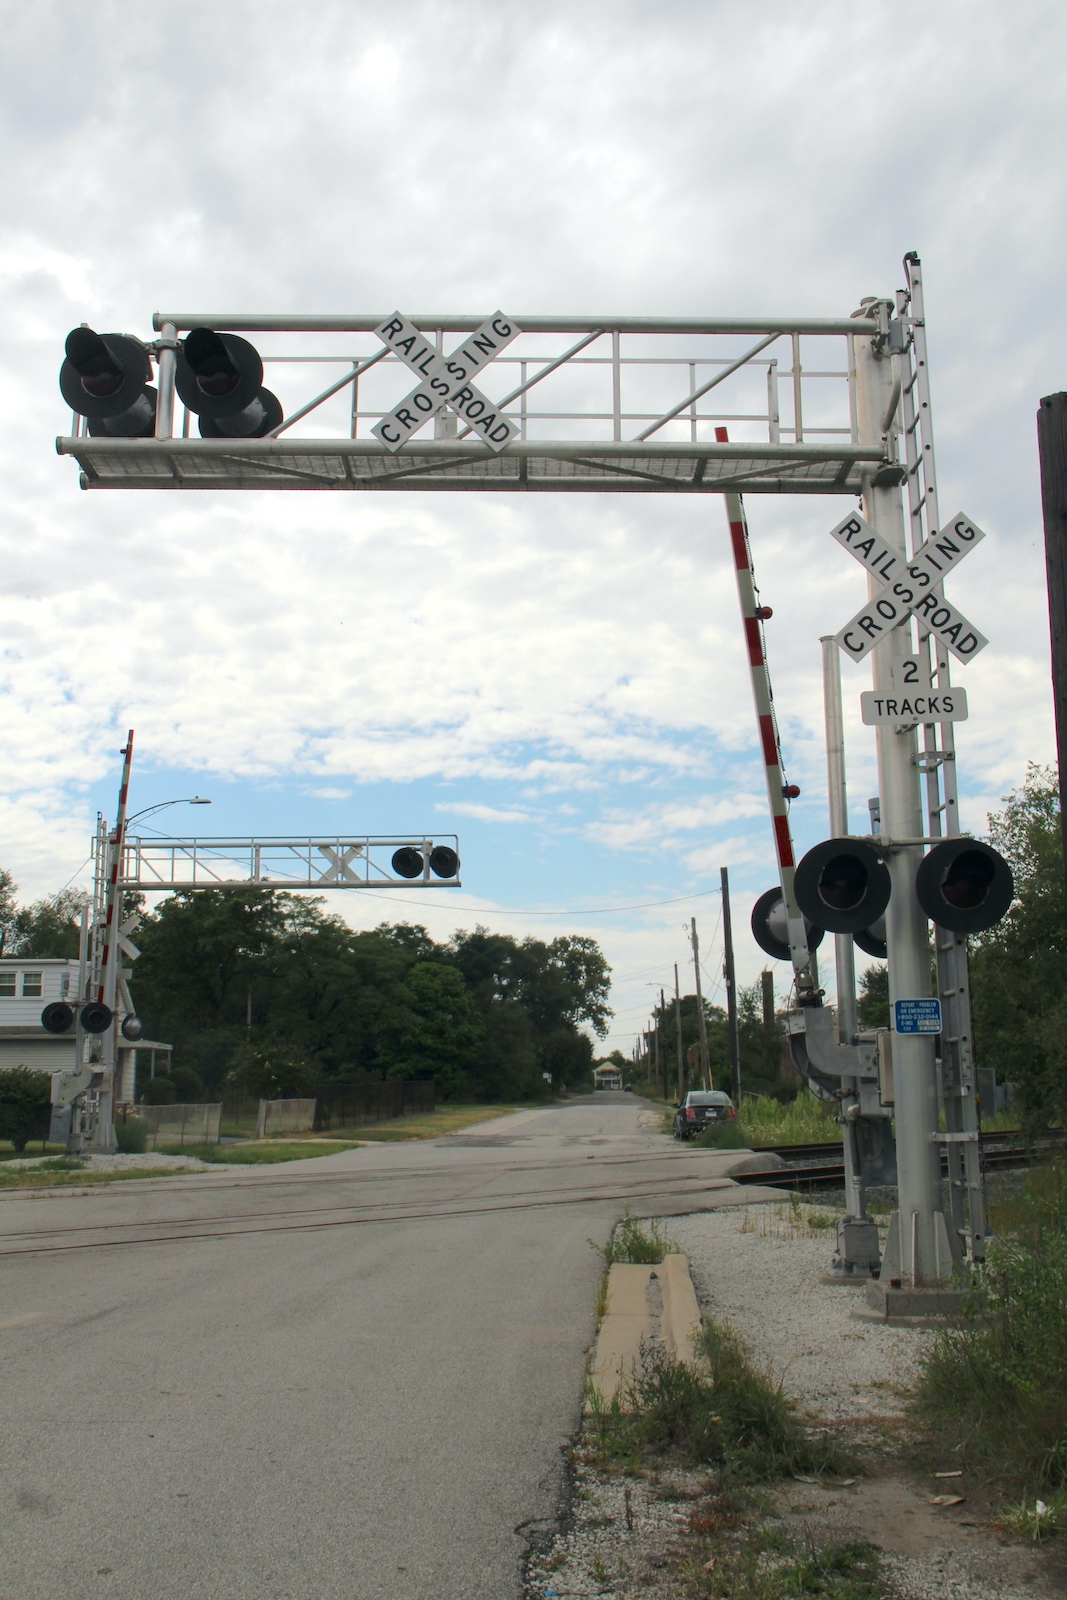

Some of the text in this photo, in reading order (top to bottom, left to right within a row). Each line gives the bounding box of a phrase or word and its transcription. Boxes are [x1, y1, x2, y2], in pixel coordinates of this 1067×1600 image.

[380, 319, 512, 443] CROSSING
[843, 521, 975, 653] CROSSING
[874, 696, 954, 716] TRACKS
[902, 661, 919, 683] 2
